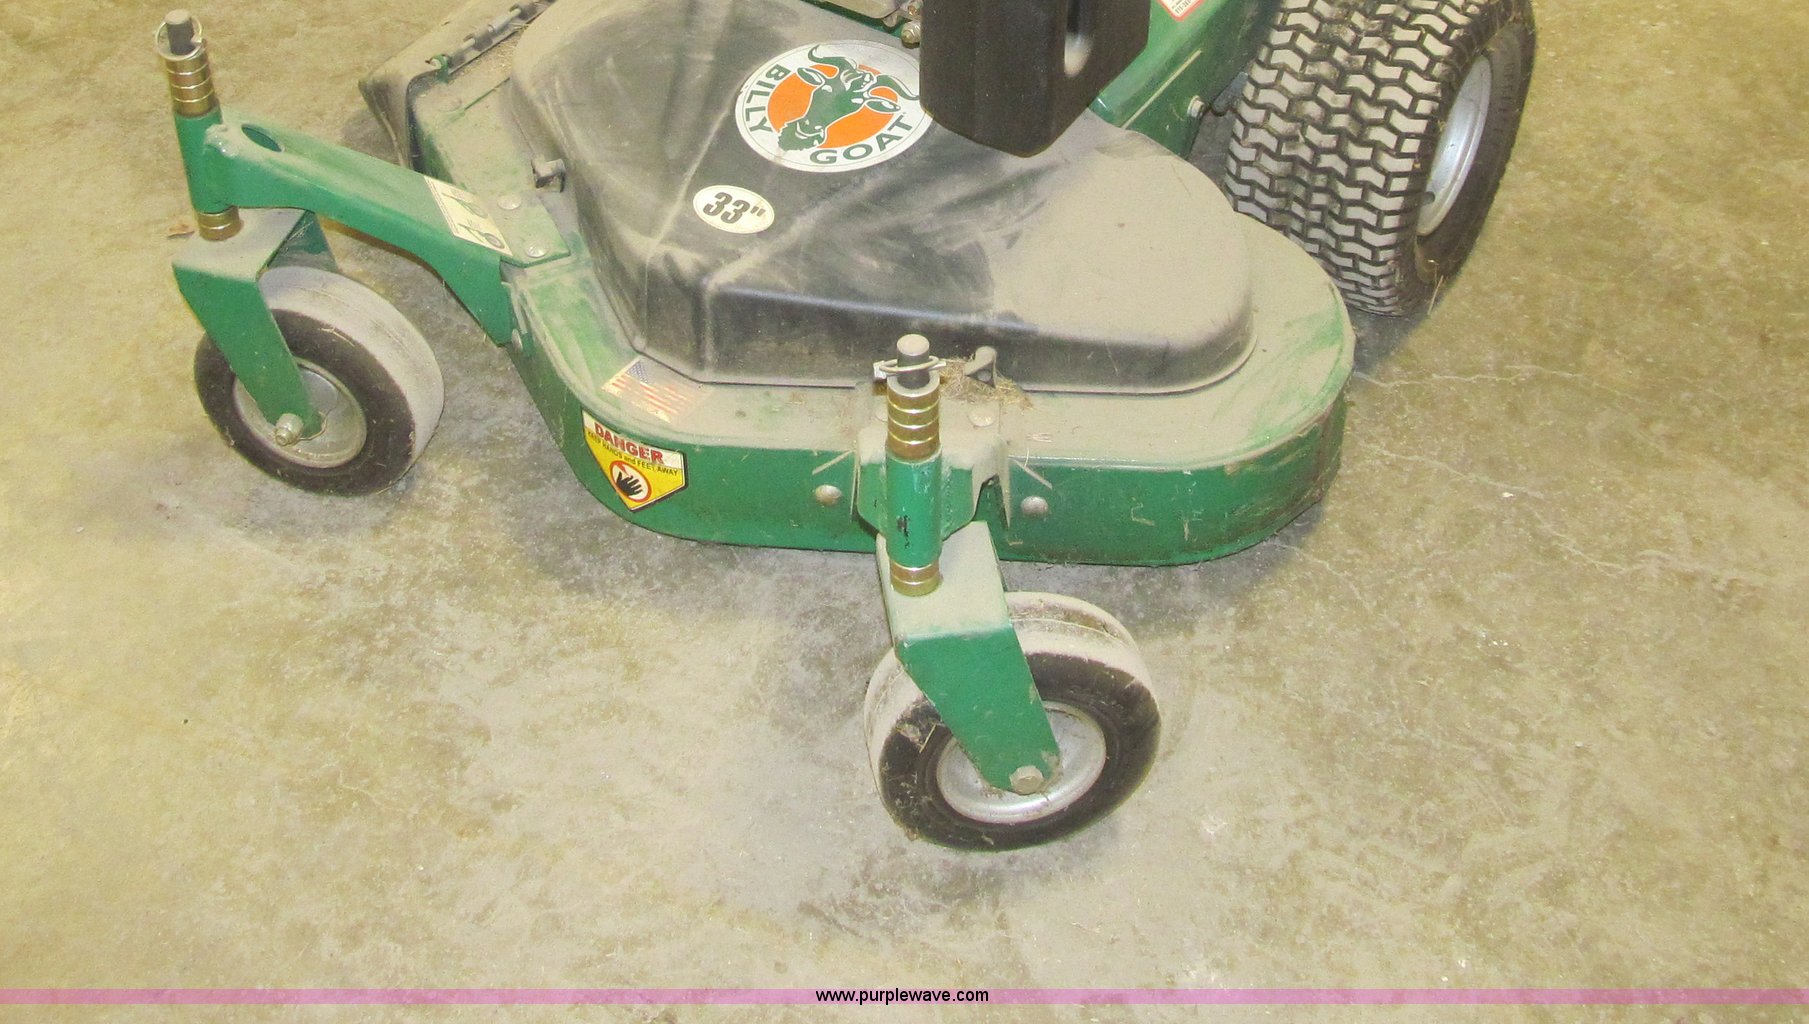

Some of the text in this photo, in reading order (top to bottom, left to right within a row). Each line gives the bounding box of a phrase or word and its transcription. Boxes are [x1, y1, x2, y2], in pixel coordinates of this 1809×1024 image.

[745, 64, 913, 164] BILLY GOAT
[702, 191, 766, 225] 33"
[594, 422, 664, 464] DANGER
[602, 442, 623, 459] HANDS
[623, 455, 636, 464] and
[657, 465, 679, 476] AWAY
